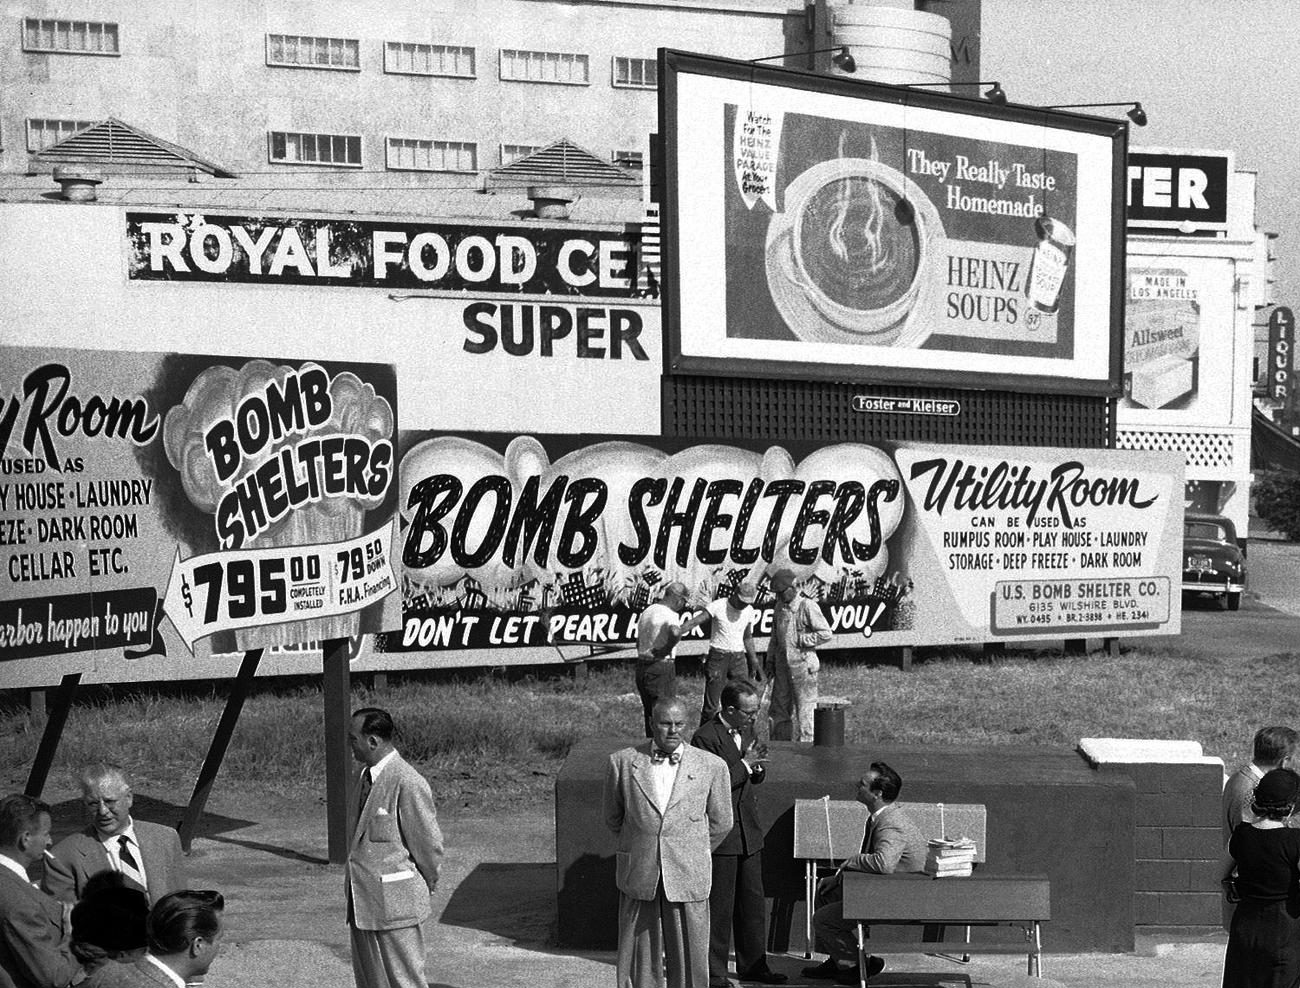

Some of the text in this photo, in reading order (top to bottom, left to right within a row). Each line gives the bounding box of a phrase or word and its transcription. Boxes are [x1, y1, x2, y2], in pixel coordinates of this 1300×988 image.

[748, 111, 771, 124] Watch
[908, 149, 1056, 190] They Really Taste
[947, 185, 1043, 218] Homemade
[141, 221, 355, 278] ROYAL
[373, 229, 537, 285] FOOD
[947, 256, 1020, 292] HEINZ
[1145, 277, 1186, 287] MADE IN
[947, 292, 1018, 324] SOUPS
[1133, 288, 1197, 299] LOS ANGELES
[463, 302, 650, 361] SUPER
[1132, 325, 1183, 347] Allsweet
[1276, 312, 1289, 398] LIQUOR
[23, 363, 158, 474] Room
[860, 396, 895, 410] Foster
[913, 400, 955, 413] Kleiser
[205, 369, 332, 481] BOMB
[2, 458, 84, 475] USED AS
[15, 482, 65, 510] HOUSE
[76, 480, 152, 508] LAUNDRY
[217, 440, 391, 550] SHELTERS
[910, 458, 1159, 529] Utility Room
[37, 516, 86, 542] DARK
[90, 514, 138, 540] ROOM
[402, 474, 899, 570] BOMB SHELTERS
[971, 517, 1087, 527] CAN BE USED AS
[943, 531, 1148, 548] RUMPUS ROOM PLAY HOUSE LAUNDRY
[9, 548, 129, 582] CELLAR ETC.
[367, 556, 385, 575] DOWN
[949, 552, 1142, 570] STORAGE DEEP FREEZE DARK ROOM
[290, 586, 325, 599] COMPLETELY
[294, 599, 323, 611] INSTALLED
[339, 576, 391, 605] F.H.A. Financing
[1002, 582, 1160, 600] U.S. BOMB SHELTER CO.
[1029, 600, 1139, 612] 6135 WILSHIRE BLVD.
[47, 603, 99, 648] happen
[105, 602, 119, 635] to
[123, 611, 148, 641] you
[402, 615, 479, 647] DON'T
[489, 615, 540, 644] LET
[548, 613, 619, 643] PEARL
